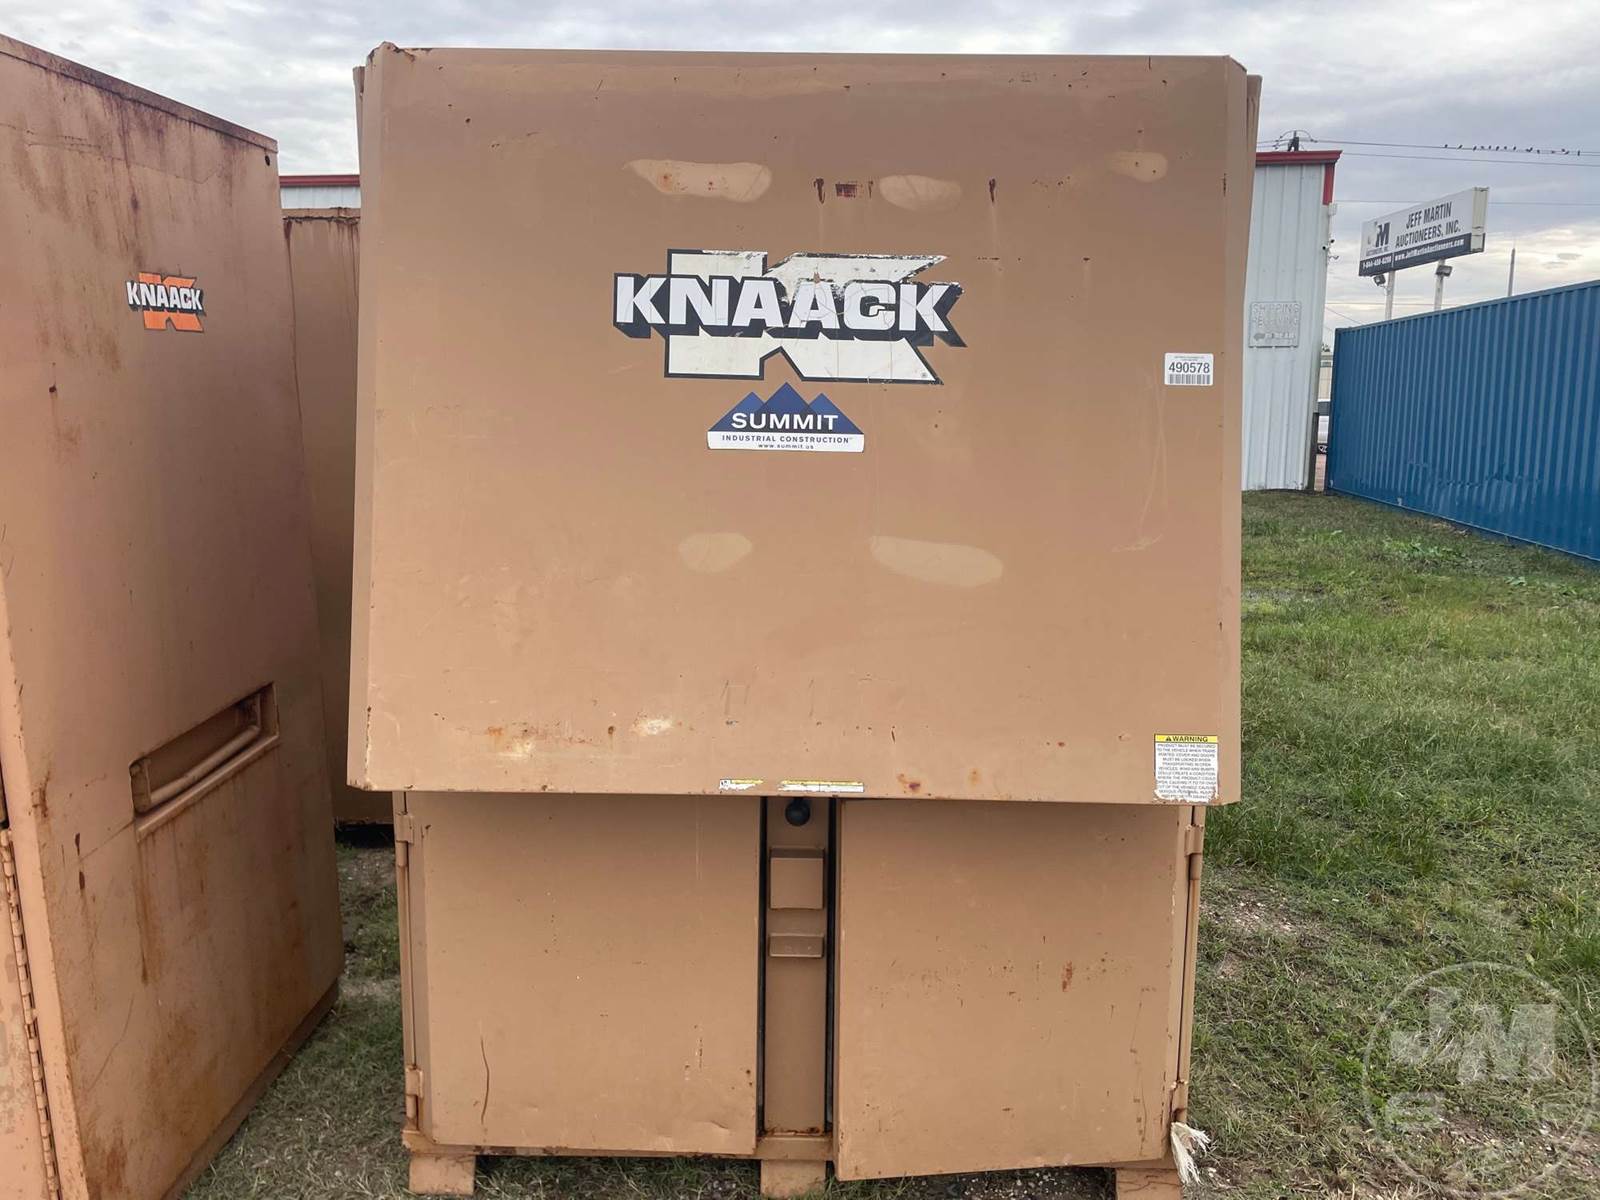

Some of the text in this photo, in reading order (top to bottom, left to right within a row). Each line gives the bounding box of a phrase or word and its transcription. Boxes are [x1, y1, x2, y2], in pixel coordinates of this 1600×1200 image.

[1406, 202, 1452, 230] JEFF MARTIN
[1395, 219, 1461, 248] AUCTIONEERS, INC.
[126, 281, 203, 311] KNAACK
[614, 274, 953, 334] KNAACK
[1168, 361, 1211, 374] 490578
[731, 412, 839, 431] SUMMIT
[722, 434, 850, 444] INDUSTRIAL CONSTRUCTION
[1172, 735, 1209, 743] WARNING
